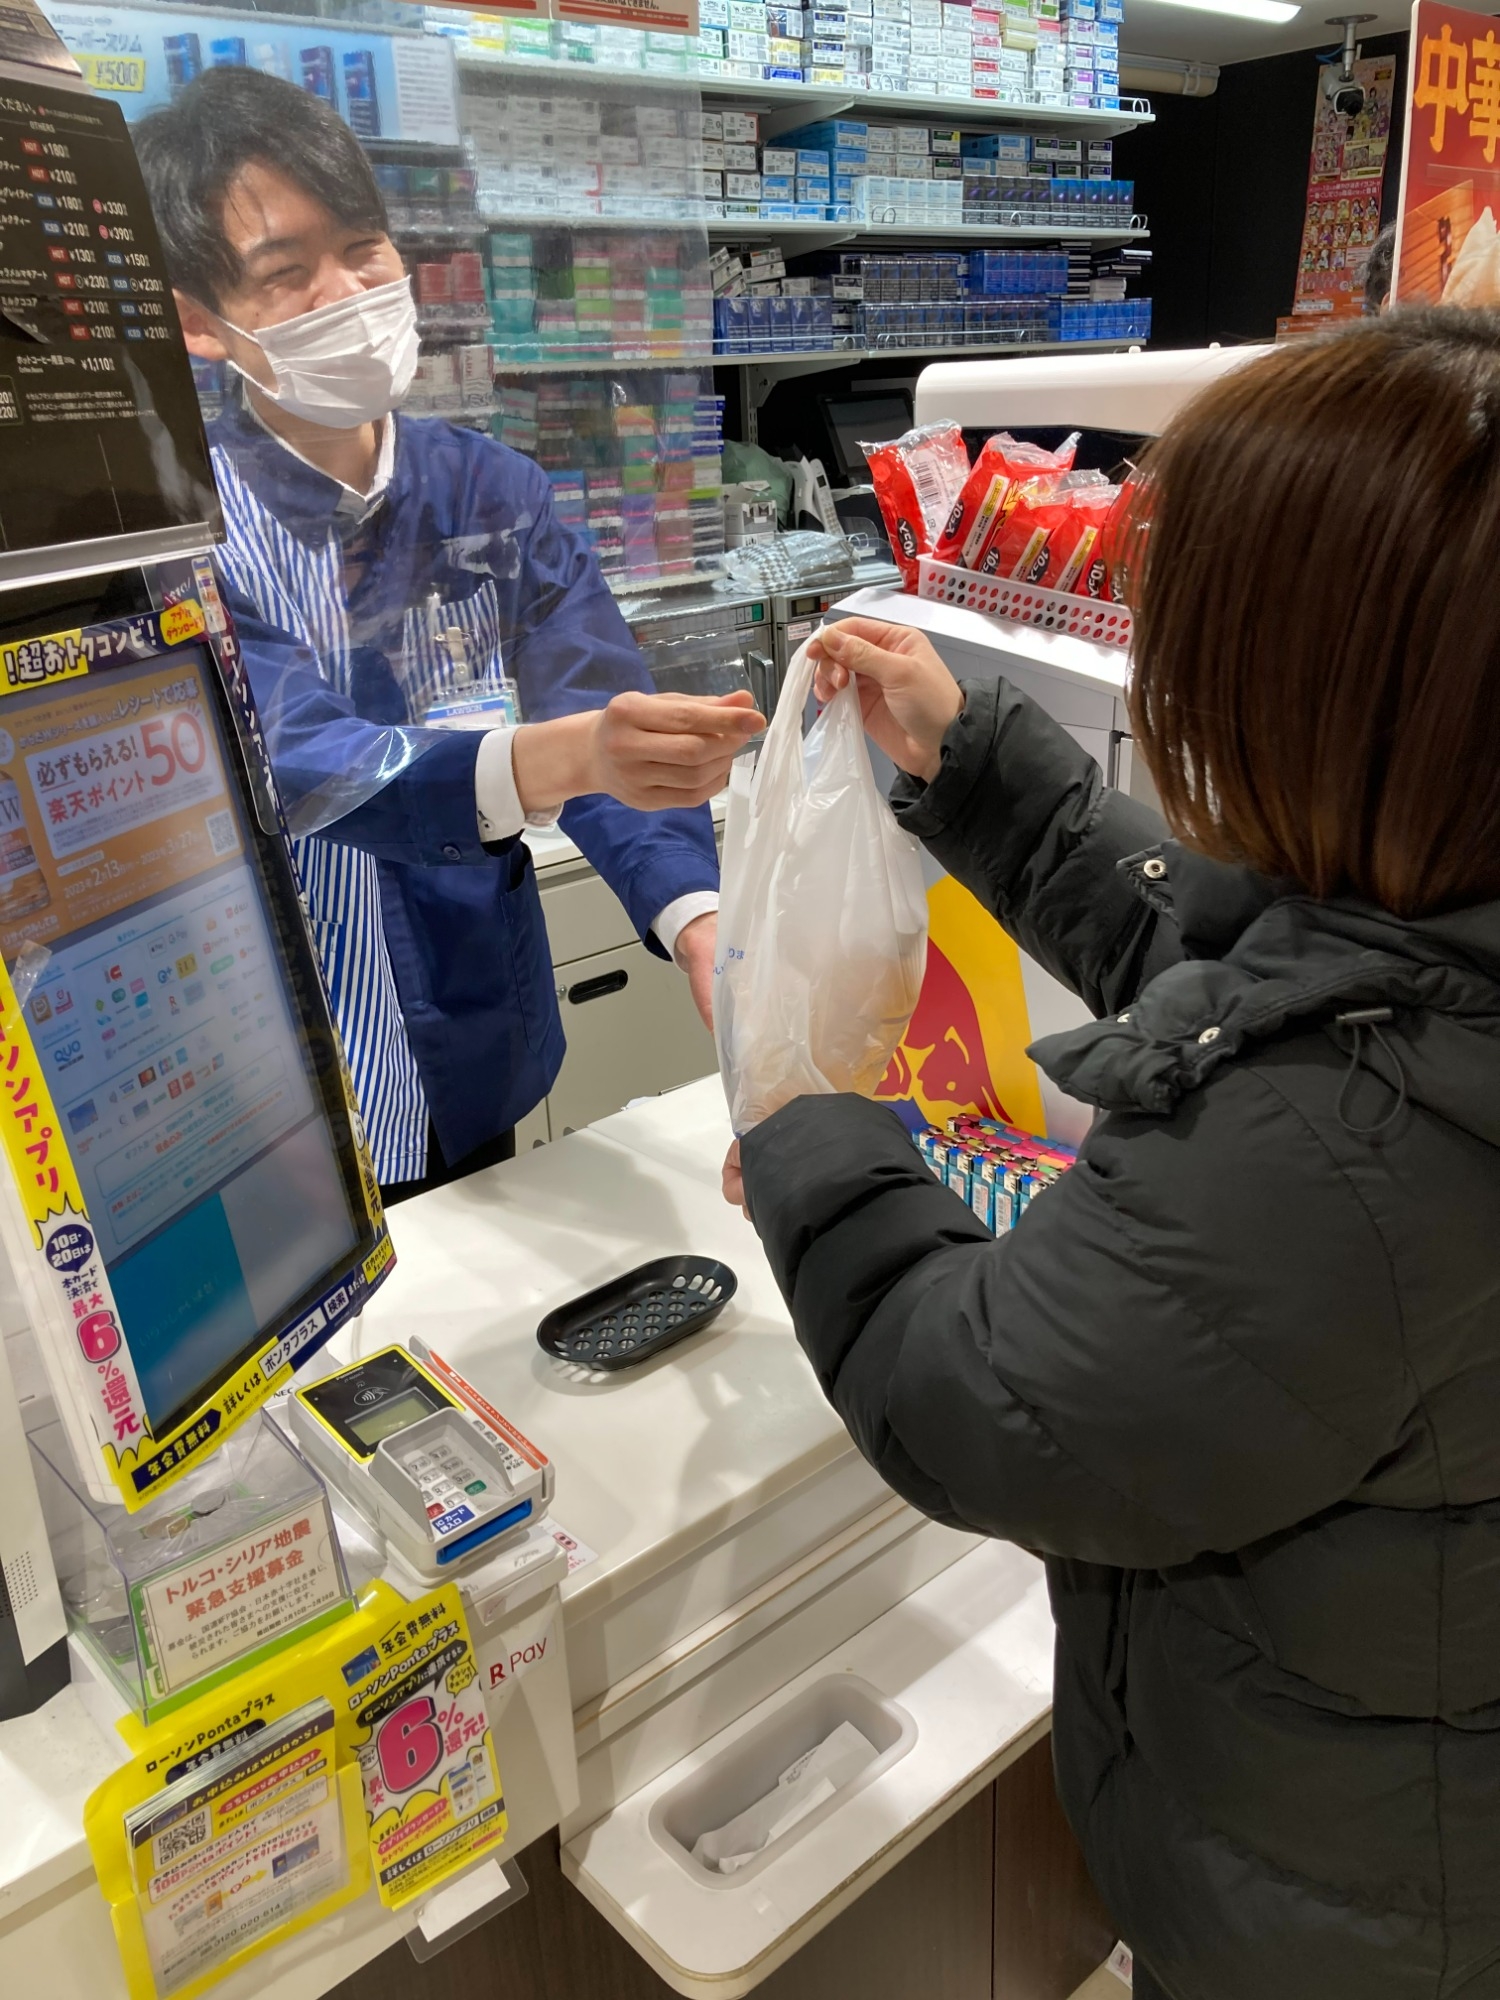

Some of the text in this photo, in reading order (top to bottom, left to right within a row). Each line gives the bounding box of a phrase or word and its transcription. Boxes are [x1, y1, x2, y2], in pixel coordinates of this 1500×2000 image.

[24, 141, 38, 152] HOT
[31, 169, 45, 180] HOT
[51, 248, 65, 259] HOT
[58, 274, 71, 286] HOT
[66, 300, 80, 312] HOT
[73, 327, 87, 338] HOT
[981, 550, 1000, 574] 10コ
[139, 711, 206, 787] 50
[47, 771, 146, 827] 楽天ポイント
[54, 1040, 81, 1063] QUO
[51, 1243, 92, 1268] 20日は
[61, 1265, 97, 1289] 本カード
[67, 1279, 99, 1300] 決済で
[72, 1293, 105, 1319] 最大
[77, 1310, 122, 1364] 6
[147, 1420, 211, 1478] 年会費無料
[222, 1372, 262, 1416] 詳しくは
[326, 1291, 347, 1314] 検索
[273, 1386, 294, 1399] NEC
[165, 1518, 313, 1605] トルコ・シリア地震
[184, 1549, 305, 1622] 緊急支援募金
[381, 1602, 447, 1655] 年会費無料
[347, 1619, 461, 1711] ローソンPontaプラス
[364, 1646, 463, 1722] ローソンアプリに連携すると
[489, 1637, 549, 1690] R Pay
[145, 1693, 276, 1773] ローソンPontaプラス
[377, 1695, 438, 1794] 6
[443, 1711, 487, 1757] 還元!
[191, 1724, 320, 1809] お申込みはWEBから!
[386, 1851, 425, 1880] 詳しくは
[425, 1819, 477, 1855] ローソンアプリ
